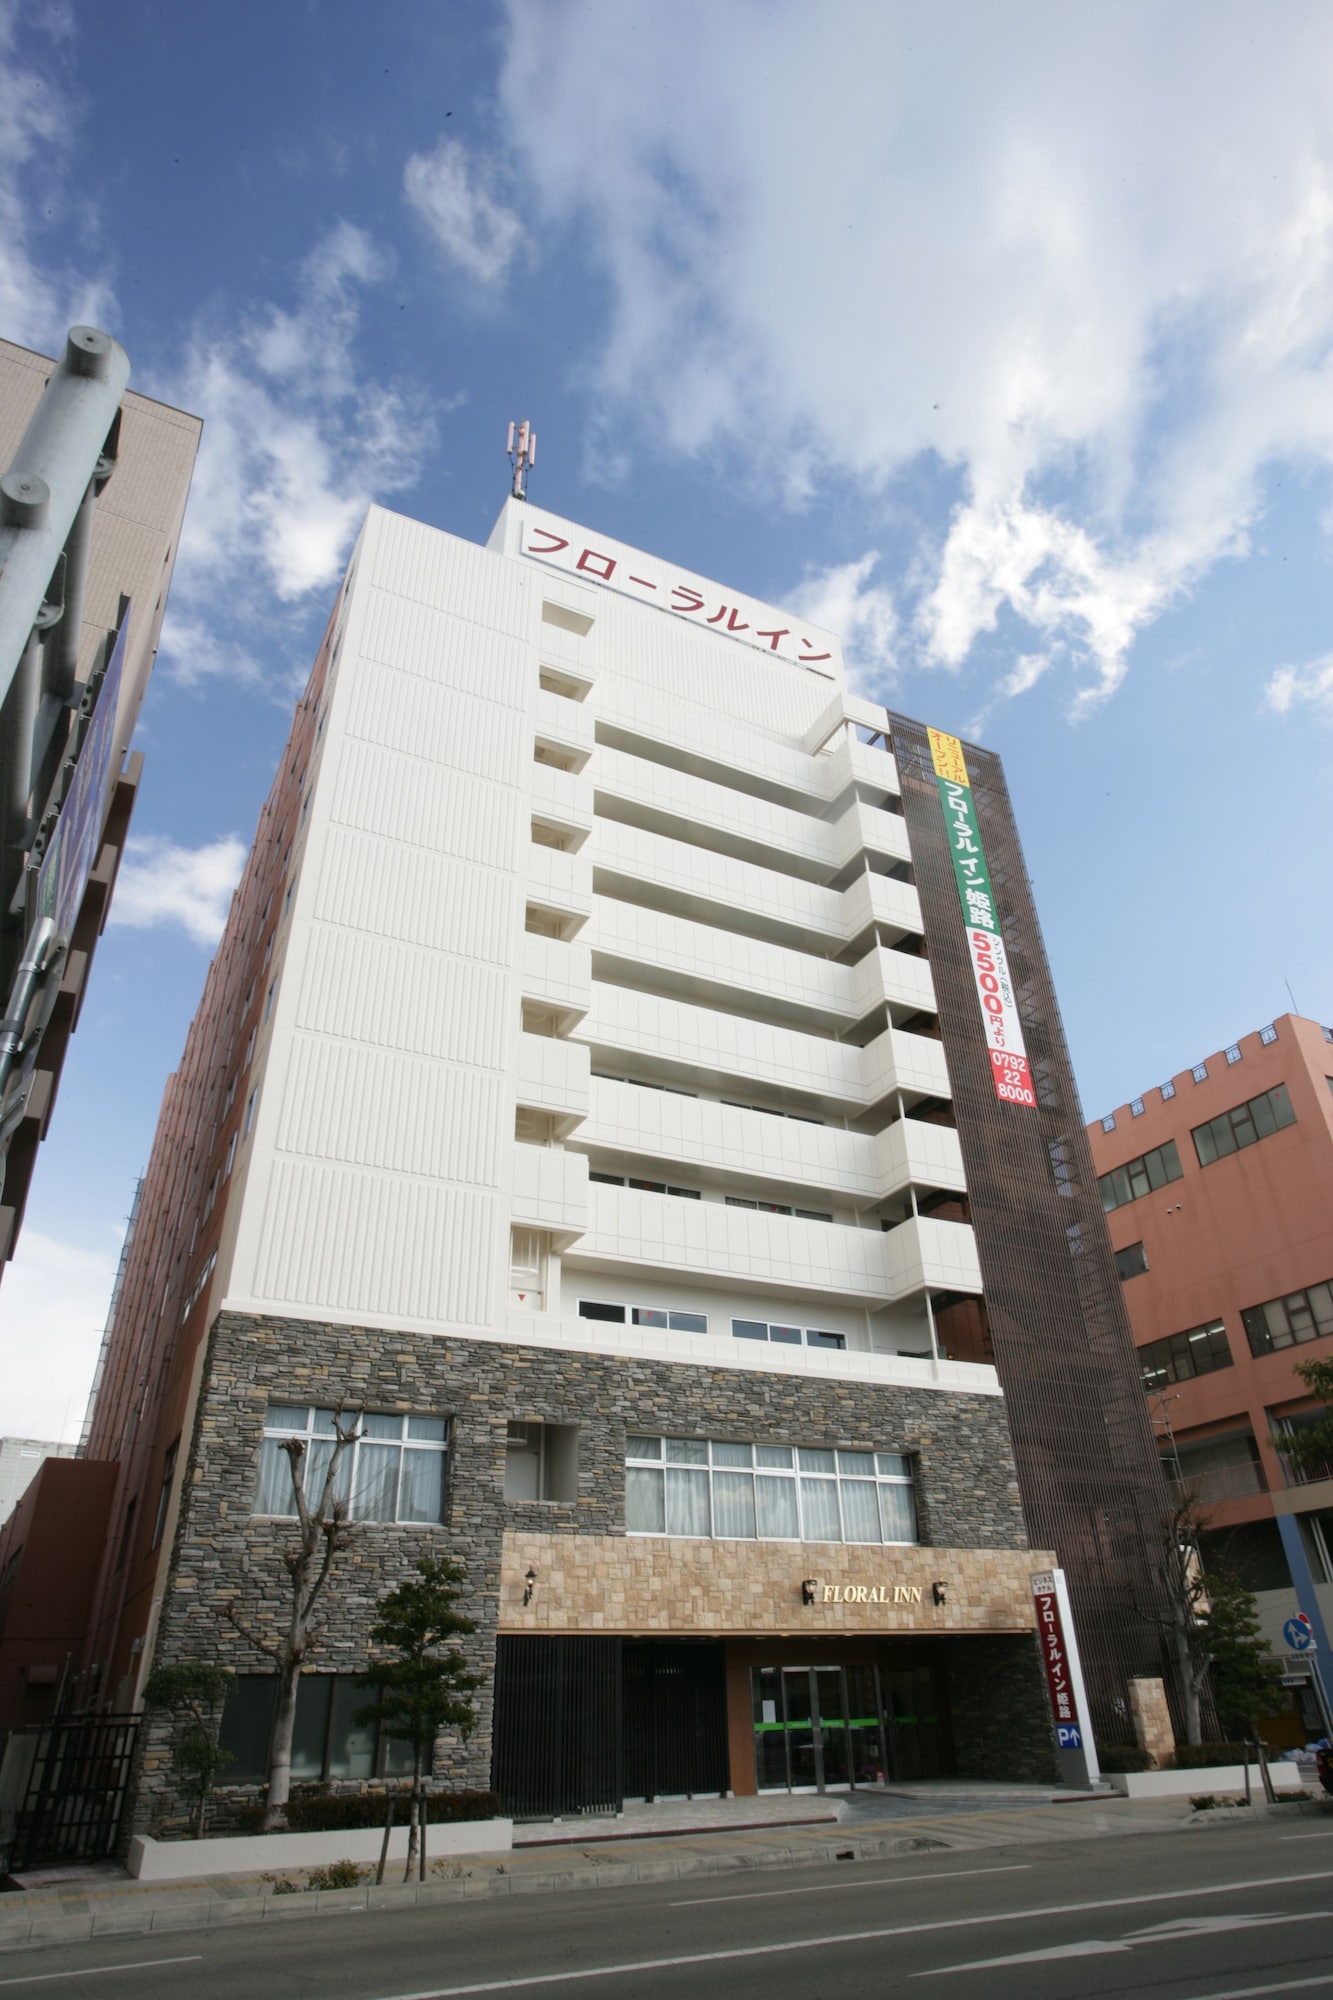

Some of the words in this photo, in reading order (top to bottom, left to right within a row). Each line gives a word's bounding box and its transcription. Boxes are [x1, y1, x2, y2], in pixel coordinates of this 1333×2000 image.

[528, 527, 832, 661] フローラルイン
[945, 736, 966, 783] リニューアル
[992, 1051, 1026, 1073] 0792
[1003, 1069, 1021, 1086] 22
[998, 1083, 1032, 1104] 8000
[822, 1585, 890, 1604] FLORAL
[893, 1586, 923, 1603] INN
[1039, 1596, 1072, 1719] フローラルイン姫路
[1057, 1727, 1068, 1746] P
